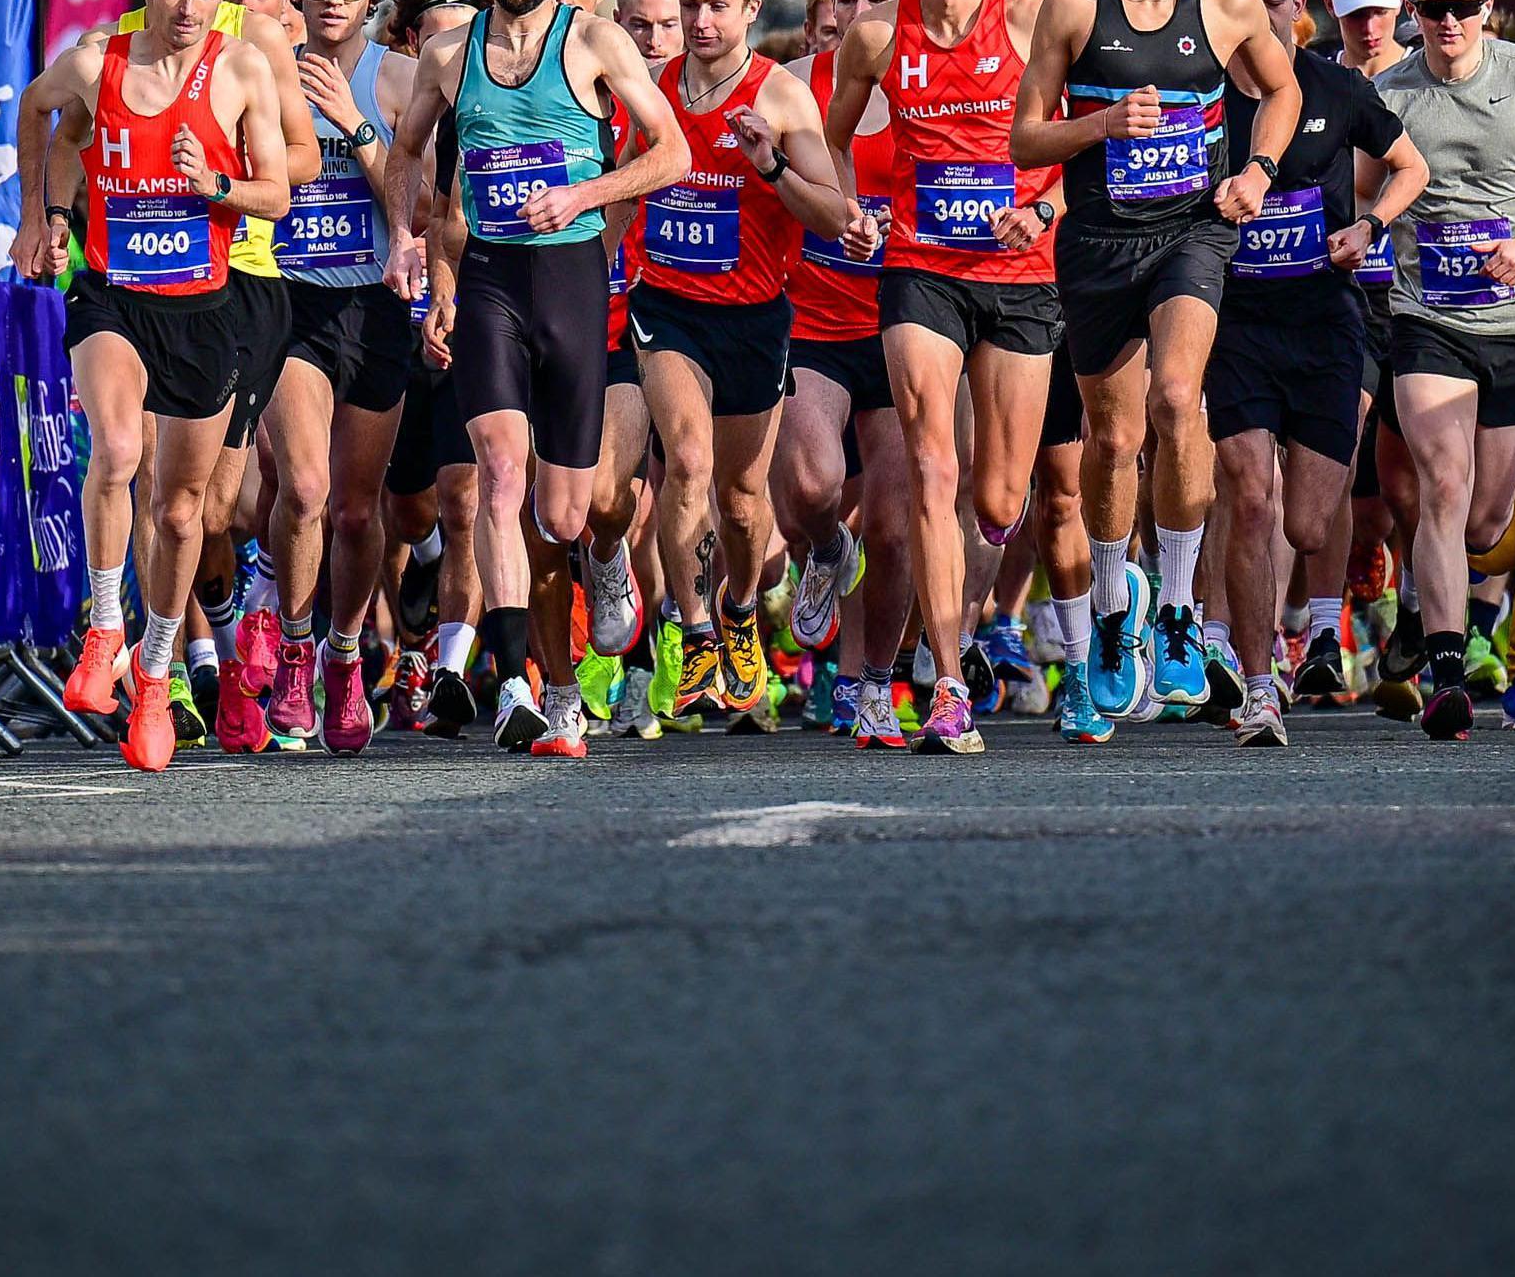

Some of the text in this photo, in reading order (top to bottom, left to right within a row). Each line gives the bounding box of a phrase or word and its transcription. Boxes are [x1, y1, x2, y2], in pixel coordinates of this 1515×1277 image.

[188, 61, 210, 102] soar
[901, 54, 928, 90] H
[898, 98, 1012, 120] HALLAMSHIRE
[101, 127, 131, 169] H
[1128, 144, 1190, 170] 3978
[96, 174, 191, 195] HALLAMSH
[681, 172, 746, 188] MSHIRE
[1143, 170, 1178, 182] JUSTIN
[934, 199, 995, 223] 3490
[291, 214, 352, 240] 2586
[659, 220, 715, 245] 4181
[952, 226, 979, 236] MATT
[1246, 226, 1306, 251] 3977
[127, 230, 191, 256] 4060
[307, 242, 338, 253] MARK
[1267, 252, 1292, 263] JAKE
[1361, 257, 1388, 267] ANIEL
